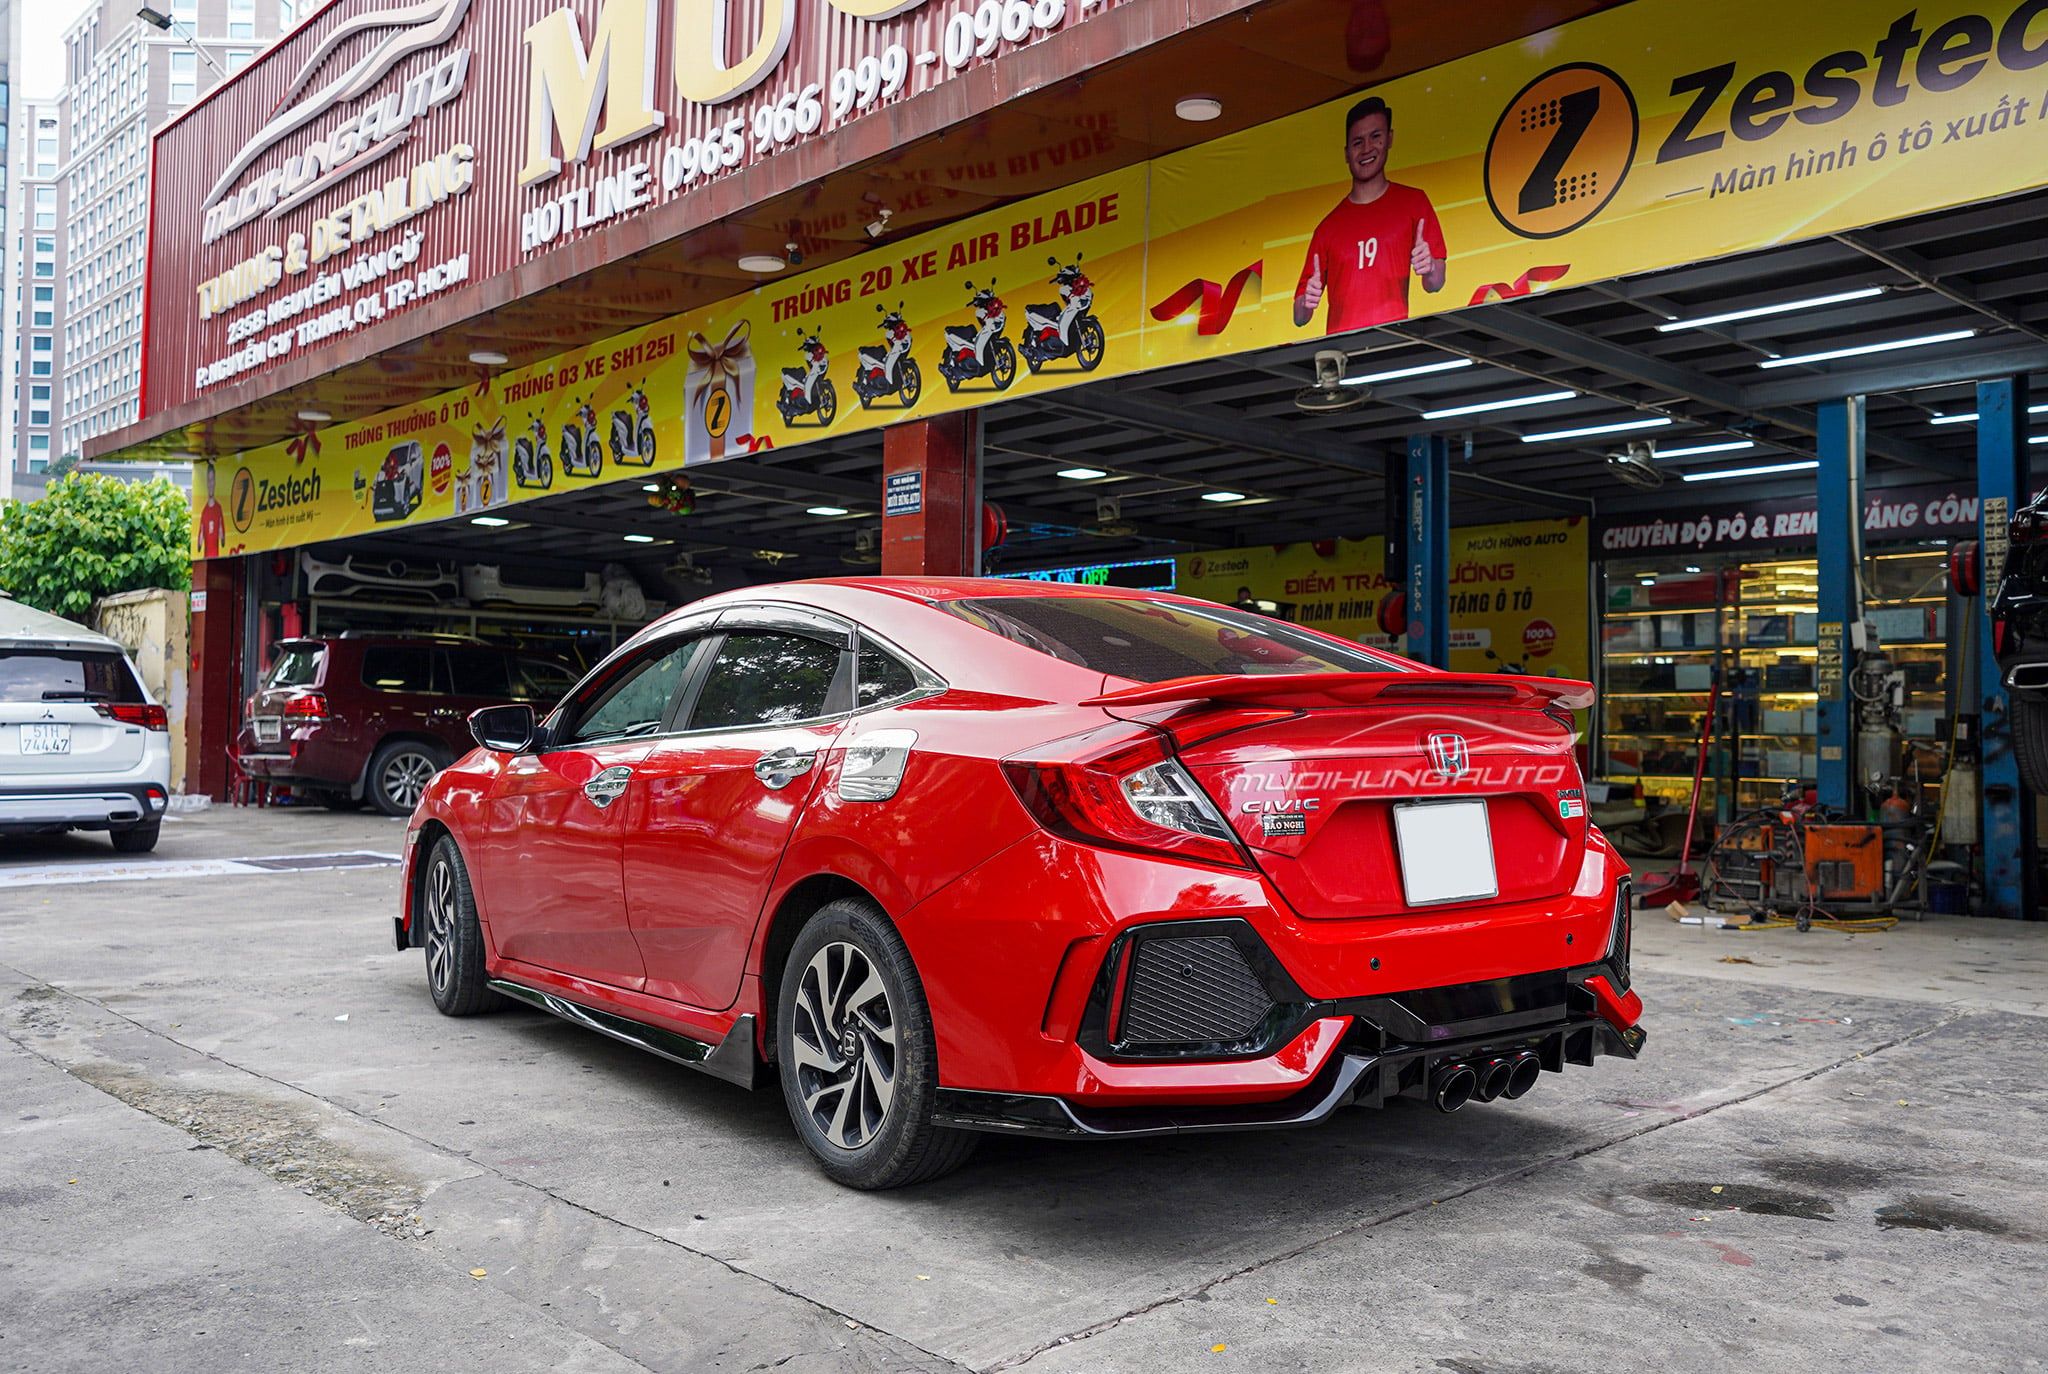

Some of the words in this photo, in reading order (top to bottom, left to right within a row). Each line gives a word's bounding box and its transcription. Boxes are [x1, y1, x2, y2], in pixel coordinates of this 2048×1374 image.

[518, 0, 926, 187] MU
[522, 162, 651, 252] HOTLINE:
[662, 117, 744, 191] 0965
[754, 83, 821, 154] 966
[832, 44, 908, 120] 999
[1709, 163, 1776, 199] Màn
[1785, 139, 1856, 181] hình
[1867, 132, 1887, 161] ô
[1899, 120, 1933, 154] tô
[1942, 94, 2030, 144] xuất
[197, 245, 283, 320] TUNING
[285, 232, 308, 275] &
[311, 143, 474, 263] DETAILING
[1357, 237, 1378, 270] 19
[385, 253, 470, 309] TP.HCM
[771, 279, 851, 323] TRÚNG
[860, 266, 892, 296] 20
[901, 251, 936, 284] XE
[947, 232, 999, 271] AIR
[1010, 193, 1119, 251] BLADE
[227, 309, 266, 345] 235B
[341, 252, 387, 290] VĂN
[504, 370, 554, 405] TRÚNG
[559, 367, 578, 388] 03
[584, 356, 605, 379] XE
[345, 423, 383, 450] TRÚNG
[387, 408, 436, 438] THƯỞNG
[440, 401, 449, 424] Ô
[453, 396, 470, 420] TÔ
[257, 467, 320, 512] Zestech
[1535, 532, 1568, 545] AUTO
[1602, 518, 1679, 550] CHUYÊN
[1680, 514, 1713, 549] ĐỘ
[1715, 512, 1747, 542] PÔ
[1751, 515, 1769, 539] &
[1208, 559, 1248, 572] Zestech
[1284, 569, 1335, 595] ĐIỂM
[1301, 600, 1334, 620] MÀN
[1338, 597, 1373, 619] HÌNH
[1495, 588, 1507, 612] Ô
[1513, 586, 1533, 611] TÔ
[1525, 627, 1554, 639] 100%
[1241, 798, 1320, 813] CIVIC
